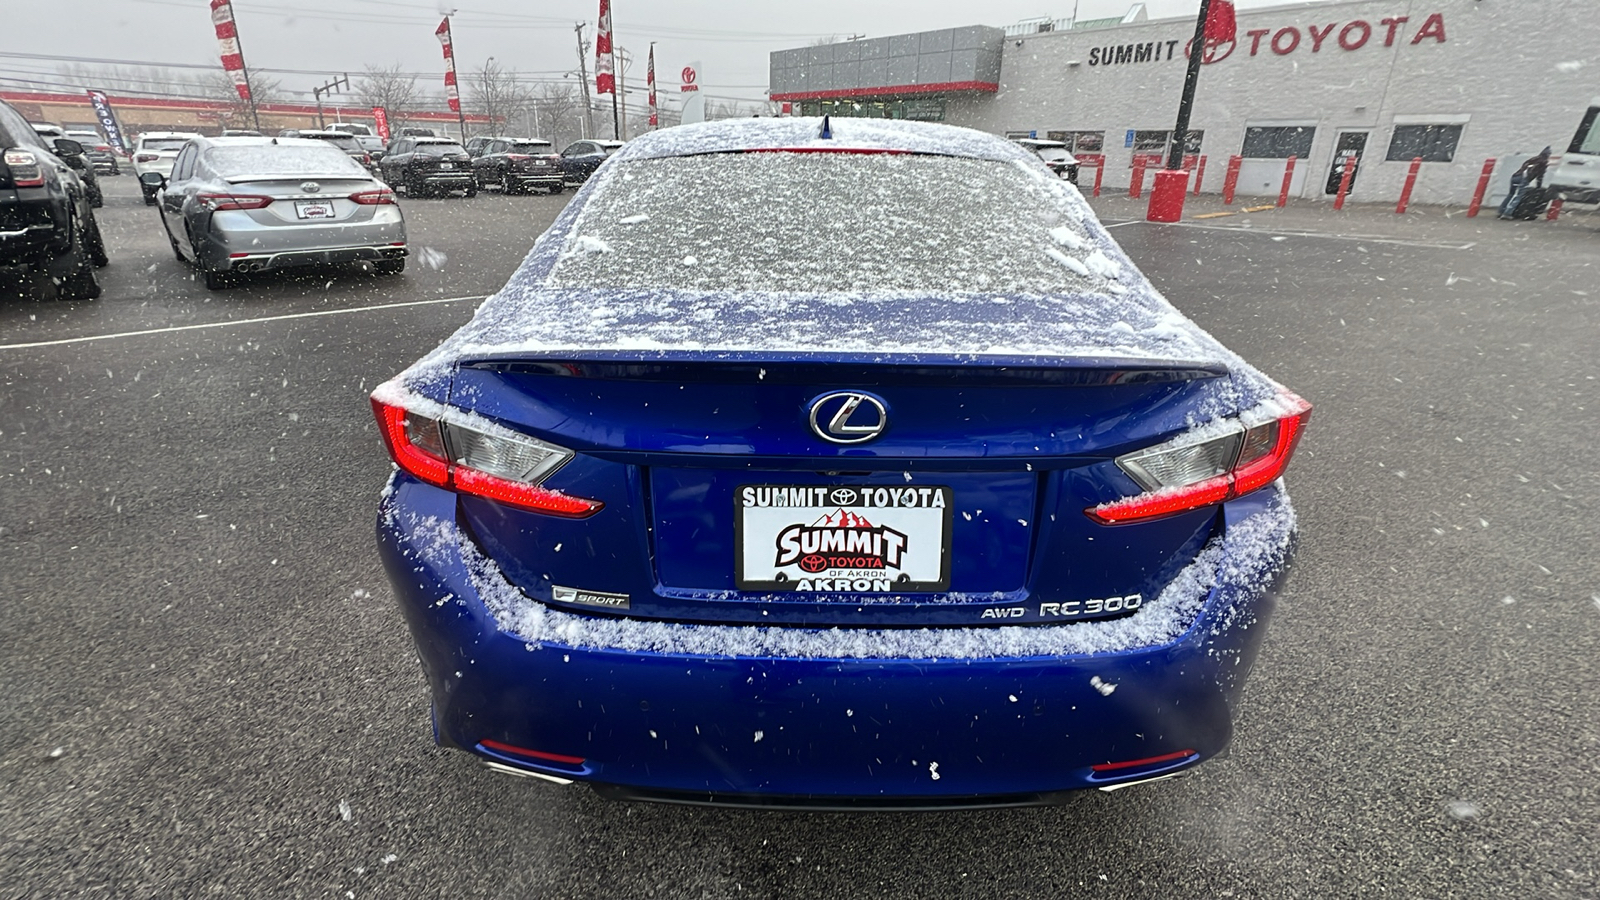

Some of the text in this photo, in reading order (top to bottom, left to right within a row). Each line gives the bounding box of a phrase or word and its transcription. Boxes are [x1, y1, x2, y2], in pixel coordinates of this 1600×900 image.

[1088, 12, 1447, 67] SUMMIT TOYOTA
[742, 487, 946, 508] SUMMIT TOYOTA
[778, 526, 905, 566] SUMMIT
[828, 556, 884, 568] TOYOTA
[847, 570, 887, 578] AKRON
[795, 578, 891, 592] AKRON
[577, 594, 625, 606] SPORT
[981, 592, 1143, 619] AWD RC 300
